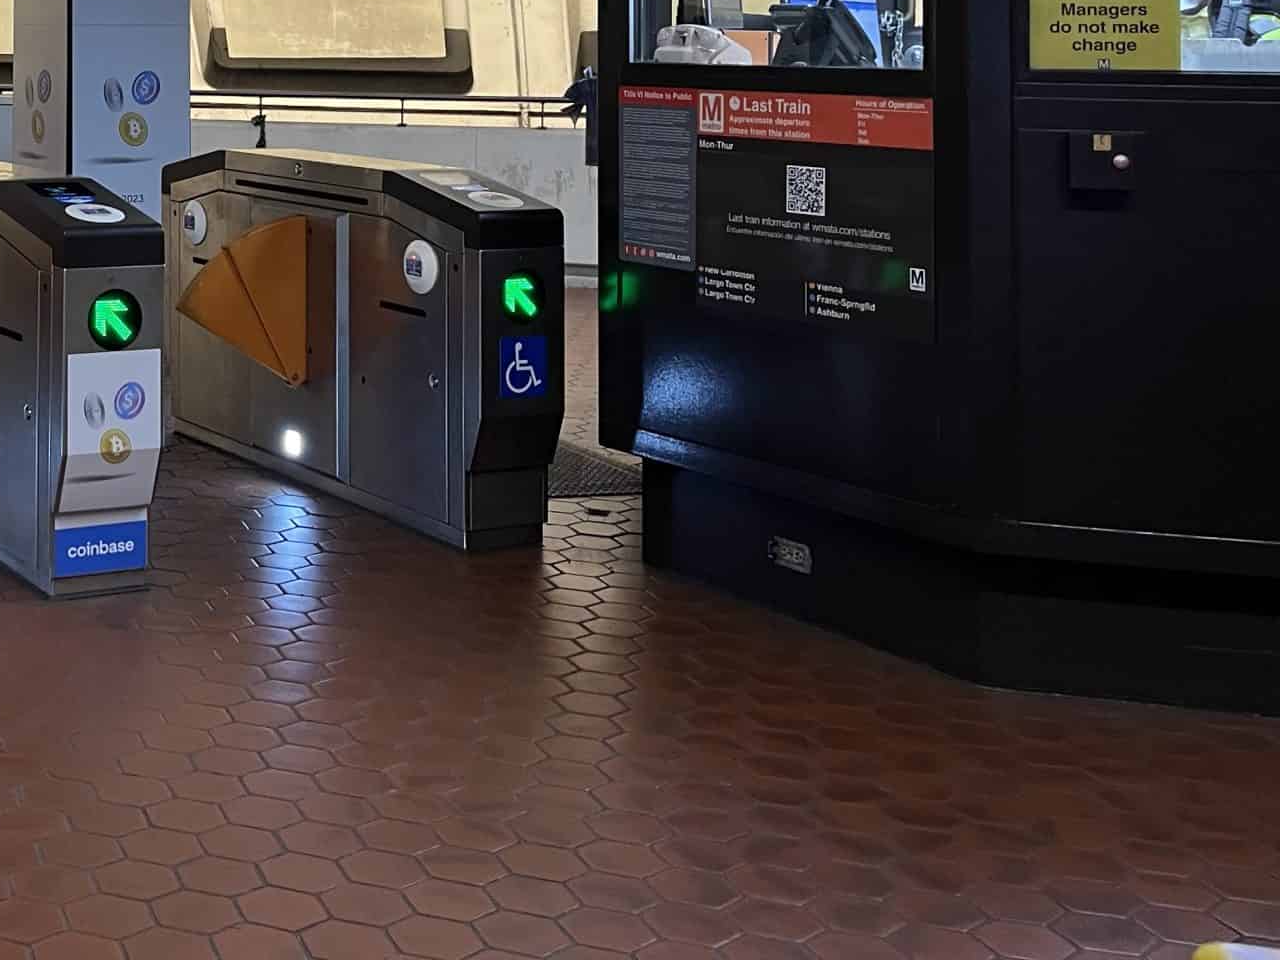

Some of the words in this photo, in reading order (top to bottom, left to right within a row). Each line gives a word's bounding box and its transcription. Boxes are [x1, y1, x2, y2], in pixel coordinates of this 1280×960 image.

[1061, 3, 1148, 19] Managers
[1049, 21, 1072, 34] do
[1078, 22, 1106, 34] not
[1112, 21, 1160, 34] make
[1072, 39, 1137, 55] change
[743, 97, 772, 113] Last
[776, 98, 811, 115] Train
[775, 117, 811, 127] departure
[750, 127, 767, 136] from
[769, 128, 783, 137] this
[784, 129, 811, 139] station
[699, 139, 734, 150] Mon-Thur
[728, 212, 744, 223] Last
[761, 217, 800, 229] information
[656, 251, 691, 262] wmata.com
[817, 306, 850, 320] Ashburn
[68, 539, 135, 559] coinbase
